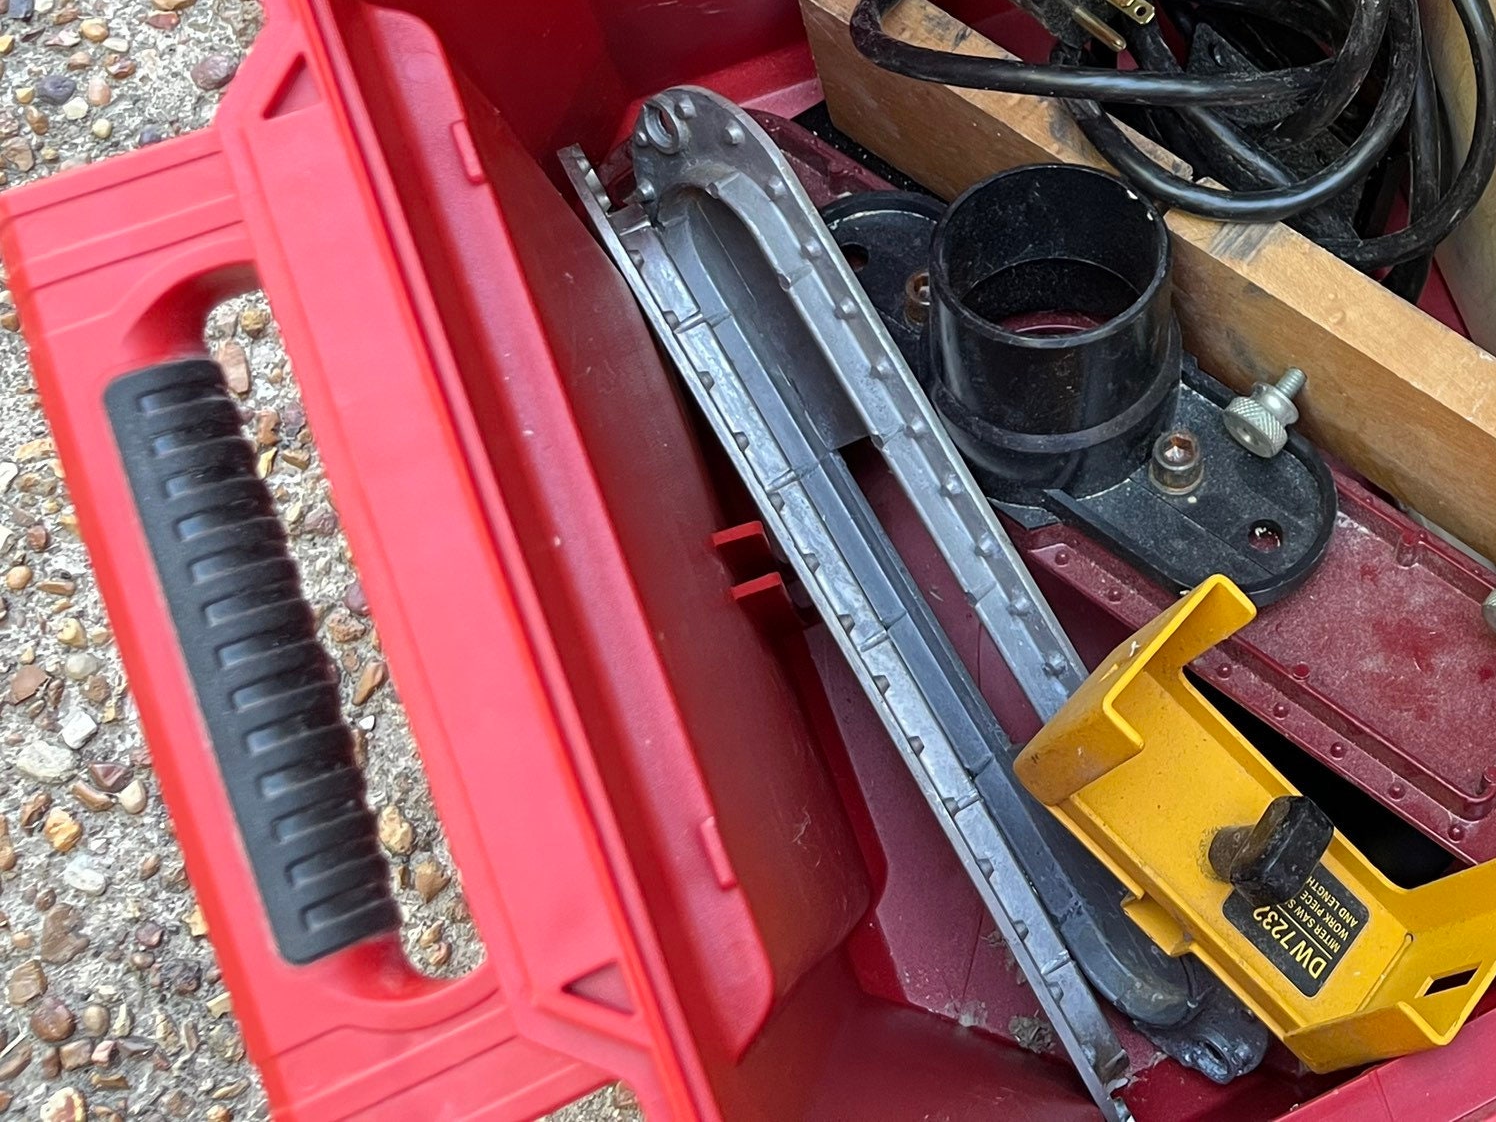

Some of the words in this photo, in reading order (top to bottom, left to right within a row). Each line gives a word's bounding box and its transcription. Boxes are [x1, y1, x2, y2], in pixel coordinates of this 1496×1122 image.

[1300, 890, 1324, 916] PIECE
[1306, 876, 1342, 912] LENGTH
[1293, 904, 1316, 928] SAW
[1322, 914, 1349, 941] WORK
[1339, 907, 1359, 928] AND
[1313, 925, 1341, 953] MITER
[1289, 939, 1328, 979] DW
